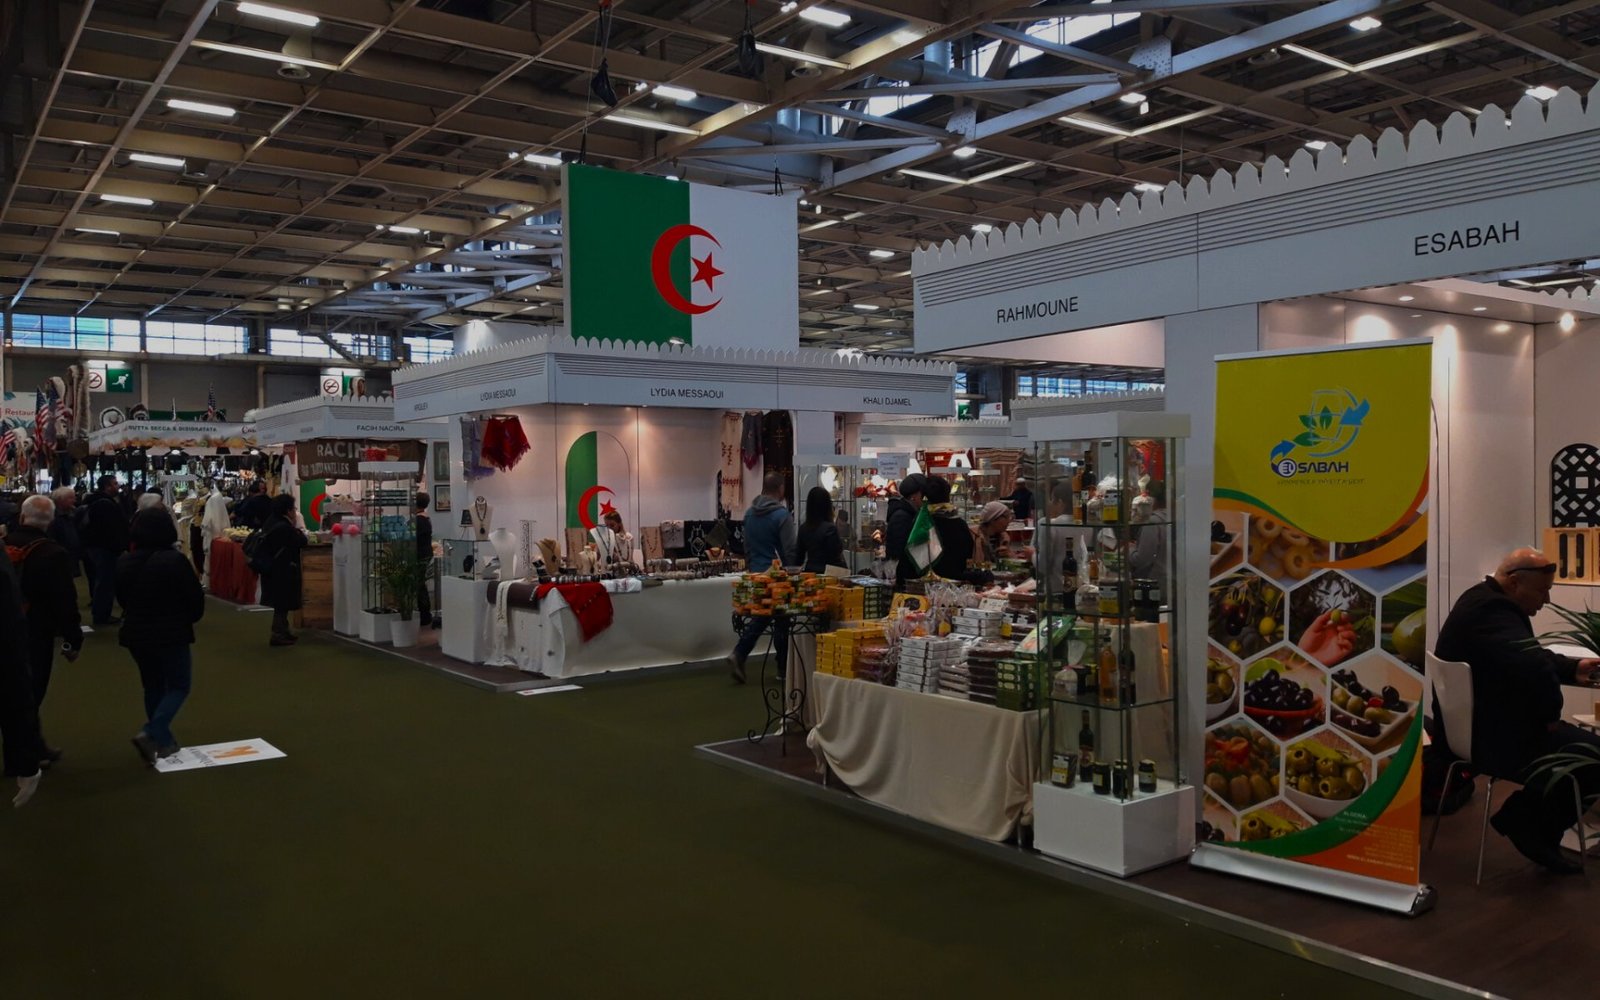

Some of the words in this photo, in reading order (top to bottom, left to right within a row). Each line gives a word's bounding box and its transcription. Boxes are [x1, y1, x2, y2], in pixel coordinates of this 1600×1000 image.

[1414, 219, 1520, 257] ESABAH
[996, 295, 1080, 324] RAHMOUNE
[650, 388, 676, 398] LYDIA
[677, 389, 724, 399] MESSAOUI
[863, 396, 885, 405] KHALI
[885, 397, 912, 406] DJAMEL
[1298, 461, 1349, 474] SABAH
